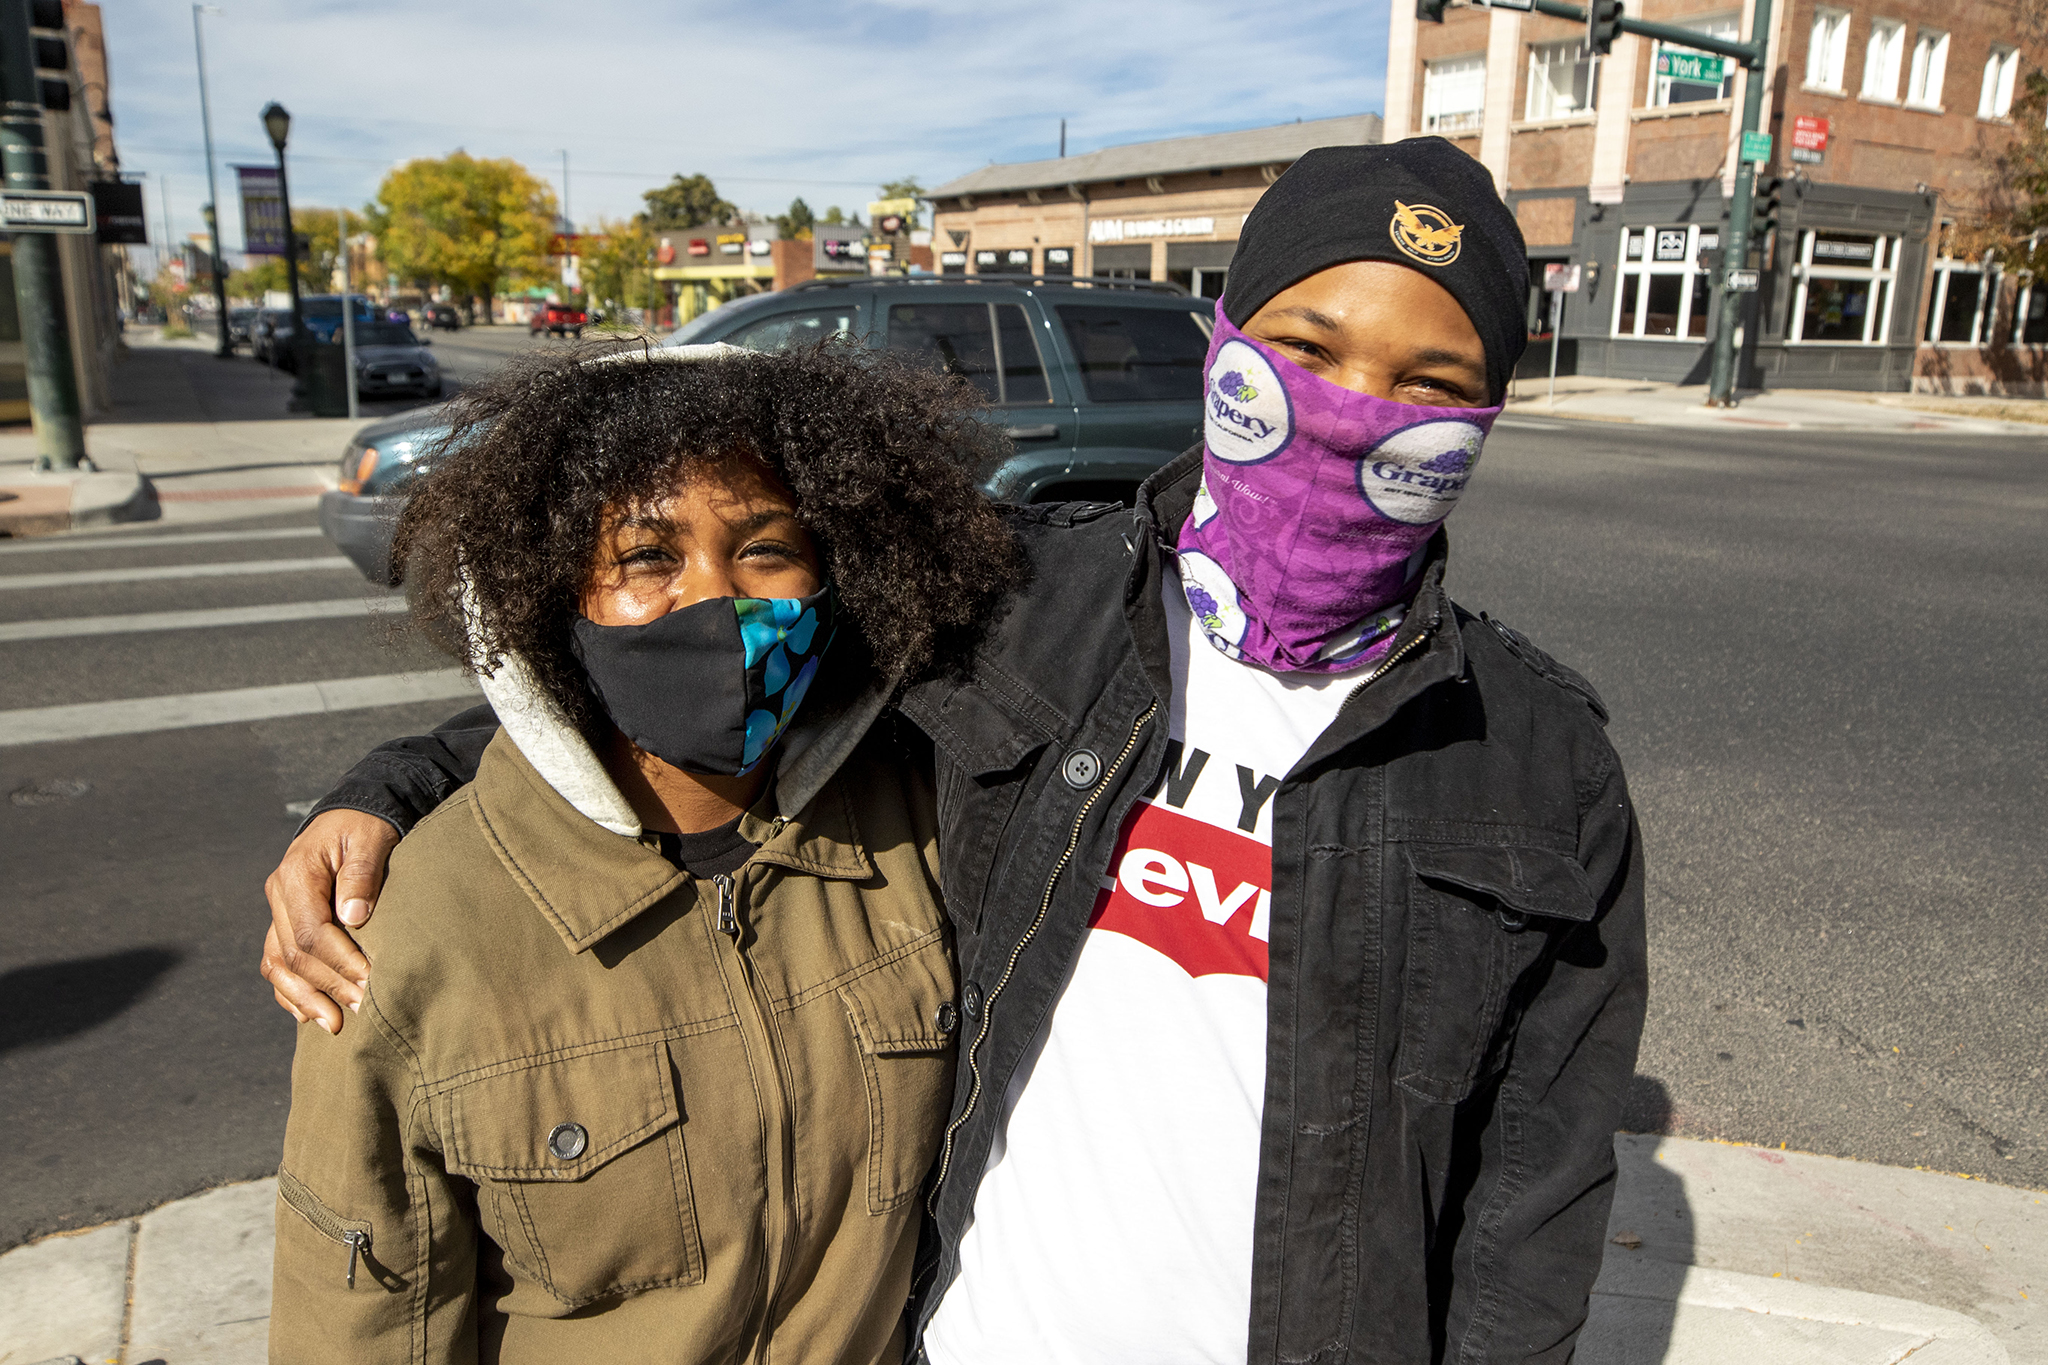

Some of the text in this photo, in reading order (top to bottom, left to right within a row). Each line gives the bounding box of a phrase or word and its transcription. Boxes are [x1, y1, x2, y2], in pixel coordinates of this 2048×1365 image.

[1672, 54, 1702, 77] York
[1371, 461, 1471, 495] Grape
[1231, 479, 1270, 504] Wow!
